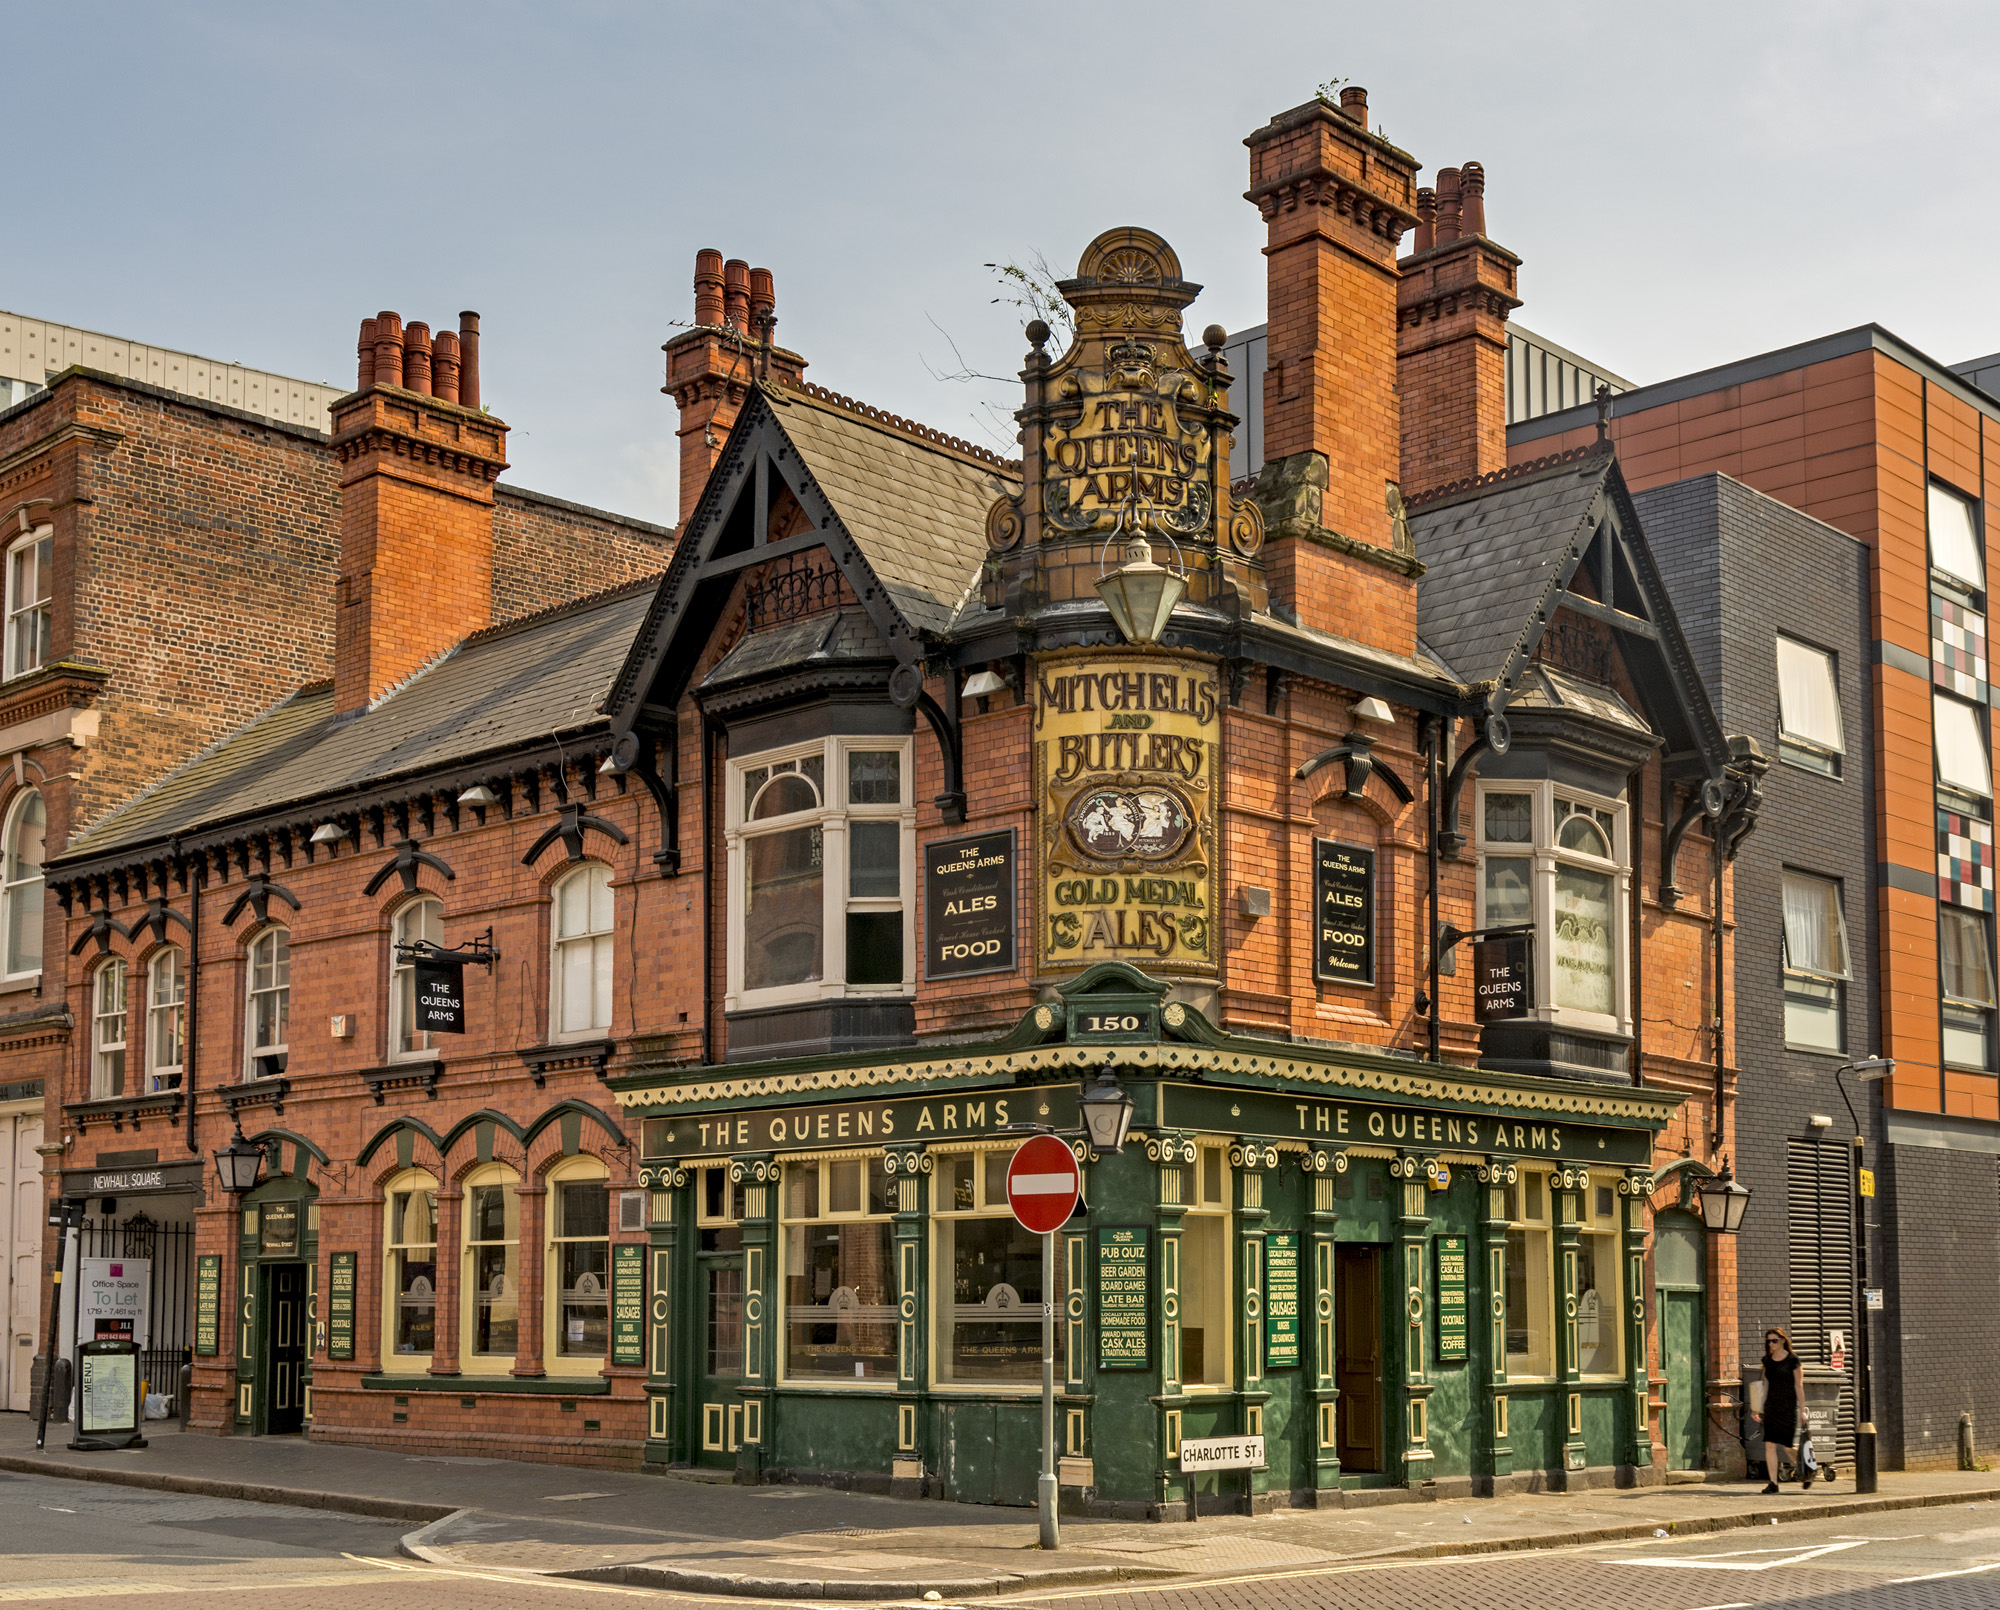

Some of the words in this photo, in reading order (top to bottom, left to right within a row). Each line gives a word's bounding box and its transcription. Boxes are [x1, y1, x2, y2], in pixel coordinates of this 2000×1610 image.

[1096, 400, 1167, 434] THE
[1055, 434, 1197, 480] QUEENS
[1075, 473, 1184, 506] ARMS
[1035, 671, 1218, 731] MITCHELLS
[1105, 713, 1154, 729] AND
[1056, 733, 1204, 782] BUTLERS
[960, 847, 979, 859] THE
[1337, 854, 1350, 863] THE
[936, 860, 976, 875] QUEENS
[977, 855, 1005, 868] ARMS
[1323, 860, 1347, 871] QUEENS
[1348, 865, 1365, 875] ARMS
[1055, 878, 1120, 906] GOLD
[1127, 878, 1205, 909] MEDAL
[1325, 891, 1363, 908] ALES
[944, 895, 997, 916] ALES
[1083, 909, 1177, 956] ALES
[1323, 929, 1365, 947] FOOD
[941, 939, 1001, 961] FOOD
[1328, 955, 1360, 970] Welcome
[1490, 967, 1510, 978] THE
[431, 983, 449, 993] THE
[1479, 981, 1521, 995] QUEENS
[421, 996, 460, 1008] QUEENS
[1486, 998, 1515, 1010] ARMS
[428, 1011, 454, 1021] ARMS
[1088, 1016, 1139, 1031] 150
[699, 1120, 749, 1147] THE
[769, 1109, 895, 1142] QUEENS
[916, 1100, 1009, 1132] ARMS
[1296, 1105, 1349, 1134] THE
[1368, 1112, 1479, 1145] QUEENS
[1496, 1123, 1562, 1151] ARMS
[94, 1174, 128, 1189] NEWHALL
[132, 1172, 160, 1186] SQUARE
[1101, 1248, 1119, 1258] PUB
[1122, 1247, 1145, 1258] QUIZ
[1101, 1267, 1116, 1277] BEER
[1118, 1267, 1145, 1277] GARDEN
[117, 1280, 139, 1288] Space
[1101, 1281, 1122, 1290] BOARD
[1124, 1281, 1145, 1290] GAMES
[93, 1291, 111, 1305] To
[116, 1291, 137, 1305] Let
[1102, 1295, 1124, 1303] LATE
[1126, 1295, 1144, 1303] BAR
[1270, 1292, 1282, 1300] AWARD
[1283, 1292, 1297, 1300] WINNING
[617, 1307, 640, 1319] SAUSAGES
[1270, 1302, 1296, 1315] SAUSAGES
[1101, 1317, 1130, 1325] HOMEMADE
[1131, 1317, 1145, 1325] FOOD
[1442, 1315, 1464, 1325] COCKTAILS
[1101, 1339, 1124, 1348] CASK
[1125, 1339, 1146, 1348] ALES
[1442, 1340, 1465, 1349] COFFEE
[84, 1362, 92, 1393] MENU
[1183, 1446, 1239, 1461] CHARLOTTE
[1245, 1445, 1256, 1458] ST
